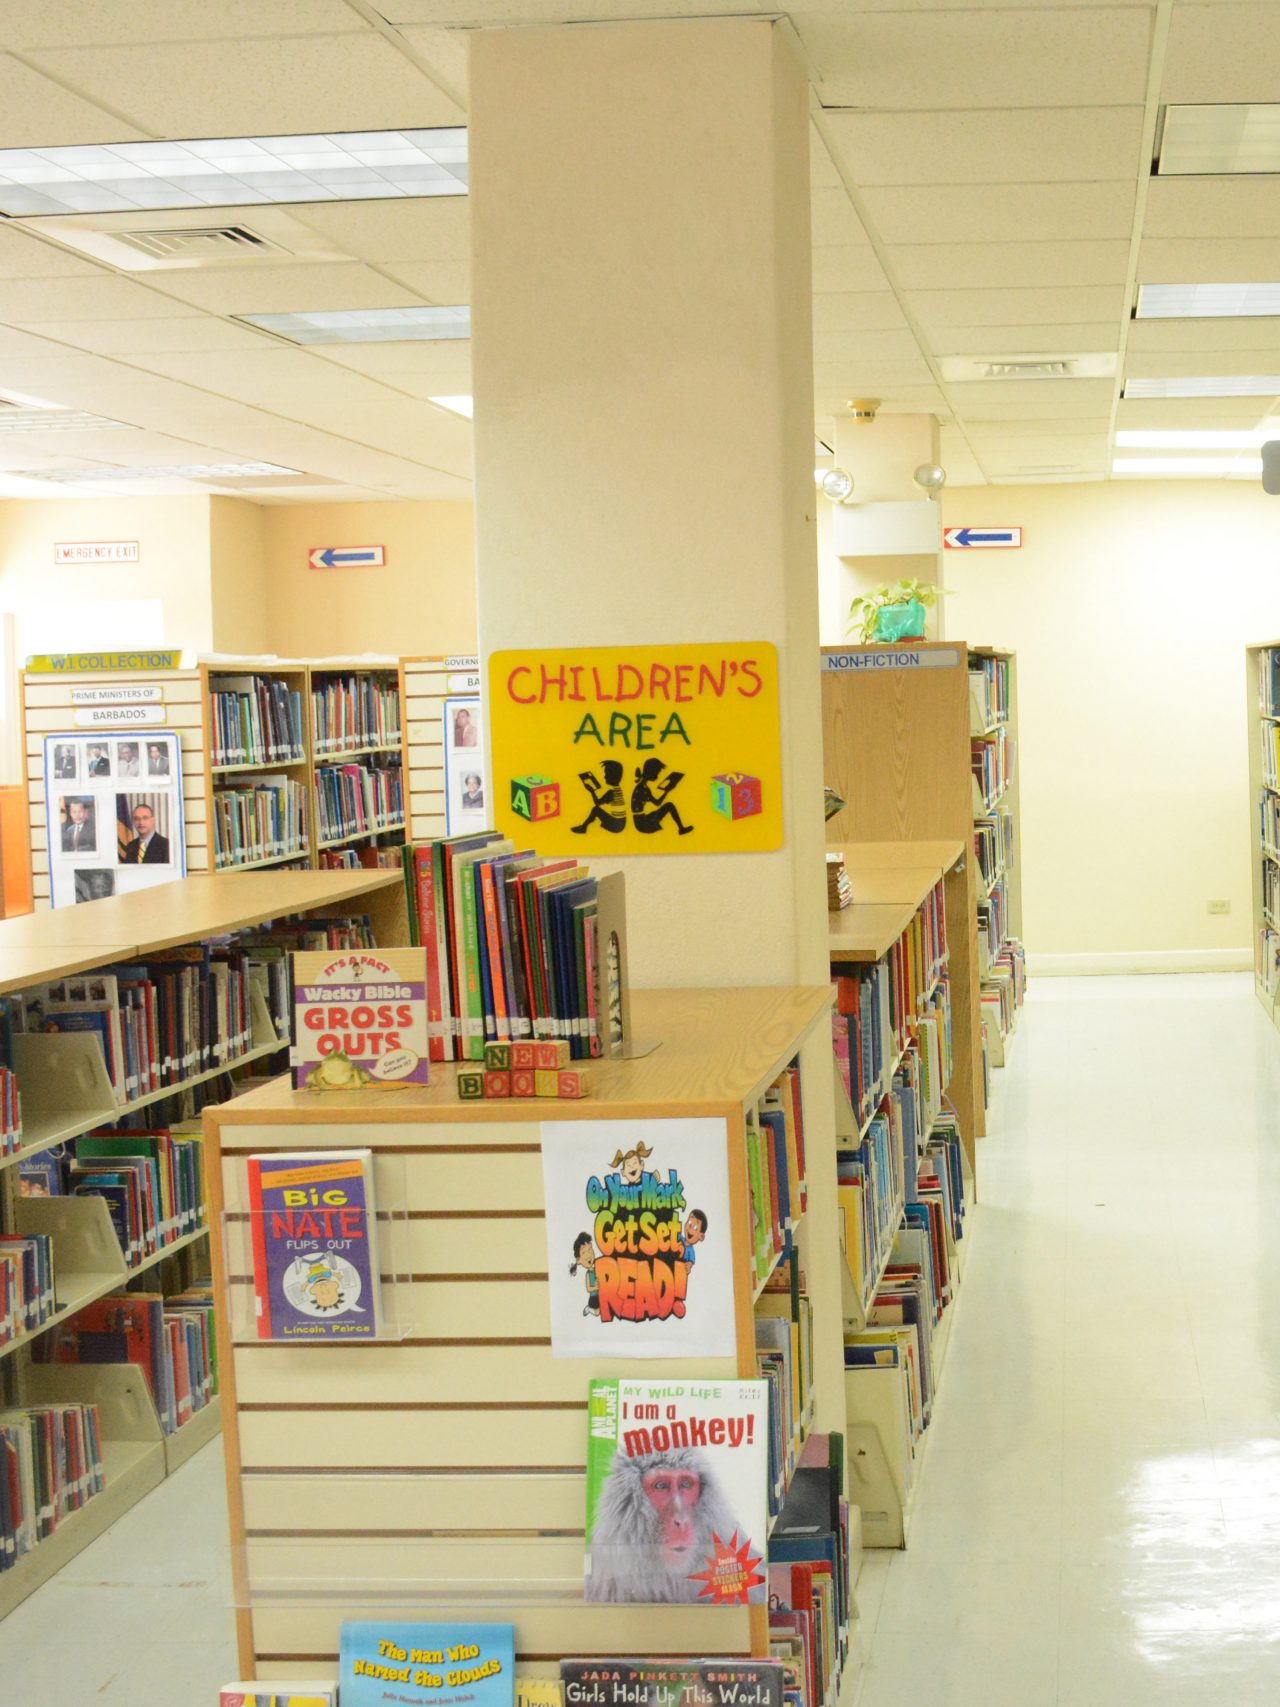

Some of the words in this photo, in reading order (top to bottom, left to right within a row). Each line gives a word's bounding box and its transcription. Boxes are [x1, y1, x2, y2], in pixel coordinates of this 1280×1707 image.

[56, 547, 112, 559] EMERGENCY
[116, 546, 137, 558] EXIT
[78, 653, 172, 669] COLLECTION
[828, 653, 920, 668] NON-FICTION
[506, 660, 763, 704] CHILDREN'S
[71, 692, 97, 700] PRIME
[98, 690, 142, 699] MINISTERS
[93, 709, 147, 720] BARBADOS
[573, 711, 691, 750] AREA
[323, 958, 347, 977] IT'S
[348, 956, 358, 965] A
[360, 956, 390, 974] FACT
[303, 987, 362, 1002] Wacky
[364, 985, 412, 1000] Bible
[303, 1004, 414, 1031] GROSS
[316, 1031, 402, 1057] OUTS
[488, 1048, 556, 1067] NEW
[586, 1175, 609, 1214] On
[604, 1172, 643, 1214] Your
[641, 1168, 687, 1212] Mark,
[271, 1206, 365, 1239] NATE
[286, 1240, 319, 1250] FLIPS
[326, 1239, 353, 1250] OUT
[594, 1210, 640, 1256] Get
[638, 1211, 685, 1260] Set,
[594, 1256, 688, 1323] READ!
[331, 1324, 371, 1334] Peirce
[623, 1387, 642, 1397] MY
[649, 1387, 685, 1400] WILD
[690, 1387, 722, 1400] LIFE
[623, 1402, 628, 1420] I
[634, 1403, 660, 1420] am
[666, 1404, 676, 1420] a
[623, 1414, 755, 1458] monkey!
[377, 1639, 408, 1663] The
[410, 1647, 445, 1665] Man
[446, 1643, 480, 1663] Who
[353, 1659, 411, 1684] Named
[413, 1669, 443, 1688] the
[445, 1658, 502, 1687] Clouds
[581, 1671, 621, 1681] JADA
[629, 1671, 699, 1681] PINKETT
[707, 1672, 759, 1682] SMITH
[566, 1682, 606, 1703] Girls
[613, 1682, 649, 1703] Hold
[655, 1686, 675, 1706] Up
[682, 1685, 713, 1704] This
[718, 1684, 771, 1705] World
